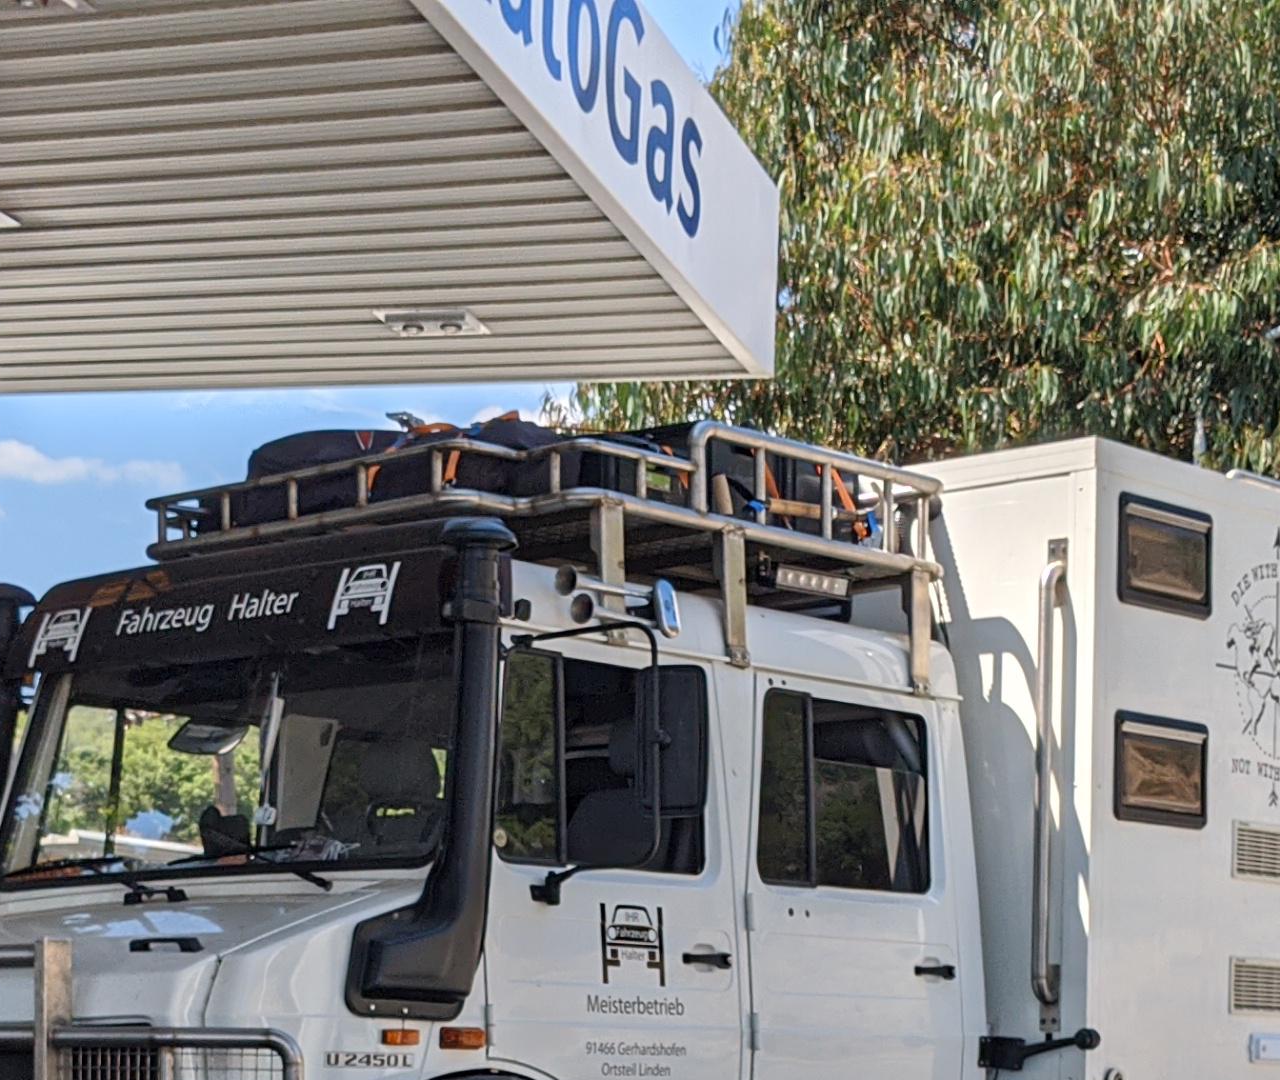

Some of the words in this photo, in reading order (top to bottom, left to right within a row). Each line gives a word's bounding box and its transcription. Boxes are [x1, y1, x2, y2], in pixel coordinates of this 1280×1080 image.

[484, 0, 704, 239] toGas
[1230, 573, 1252, 608] DIE
[1251, 562, 1279, 583] WITH
[115, 600, 215, 636] Fahrzeug
[227, 588, 299, 622] Halter
[1231, 757, 1252, 776] NOT
[1256, 760, 1280, 782] WITH
[586, 994, 685, 1017] Meisterbetrieb
[326, 1053, 340, 1067] U
[585, 1041, 616, 1055] 91466
[617, 1041, 687, 1057] Gerhardshofen
[601, 1063, 637, 1077] Ortsteil
[638, 1064, 671, 1077] Linden
